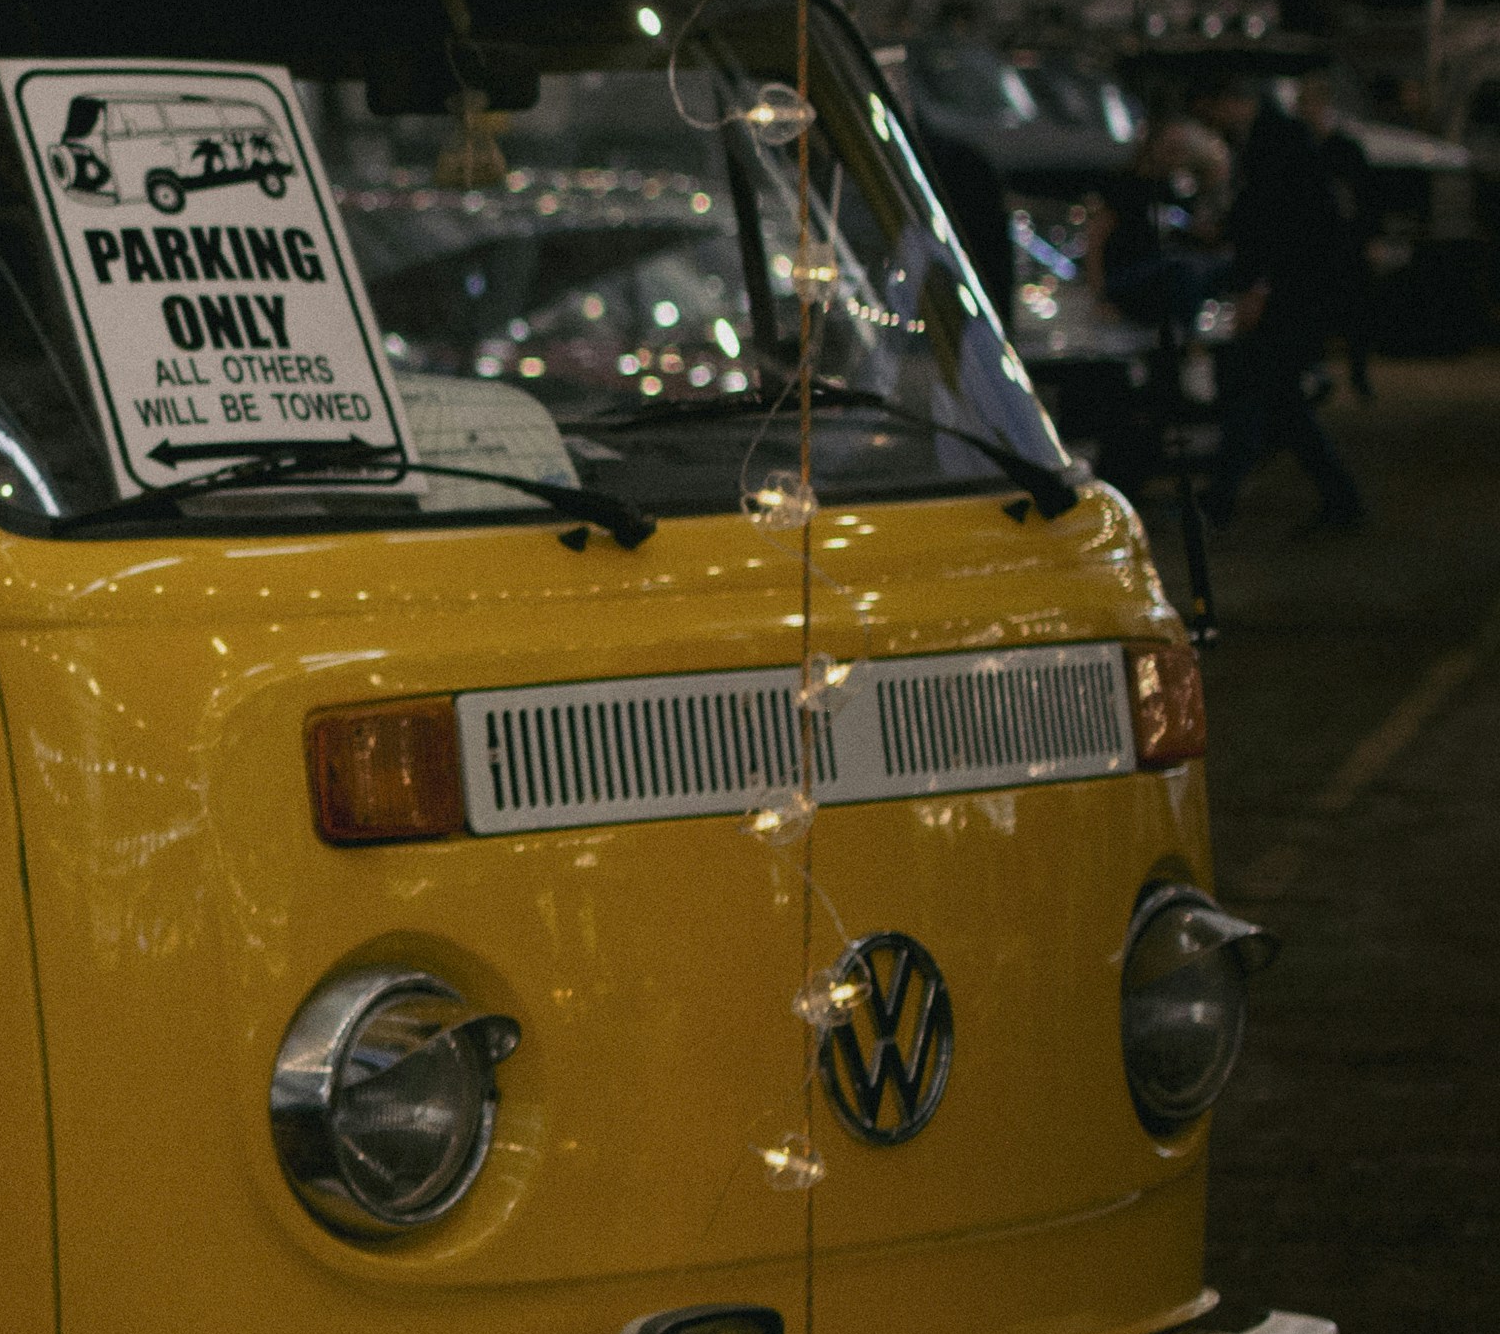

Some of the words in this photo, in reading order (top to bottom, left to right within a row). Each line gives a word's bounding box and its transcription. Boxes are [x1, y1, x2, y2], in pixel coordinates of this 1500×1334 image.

[83, 226, 326, 283] PARKING
[161, 295, 291, 352] ONLY
[156, 357, 210, 387] ALL
[222, 355, 336, 385] OTHERS
[135, 395, 209, 428] WILL
[220, 394, 261, 424] BE
[275, 393, 372, 423] TOWED
[819, 930, 955, 1146] VW
